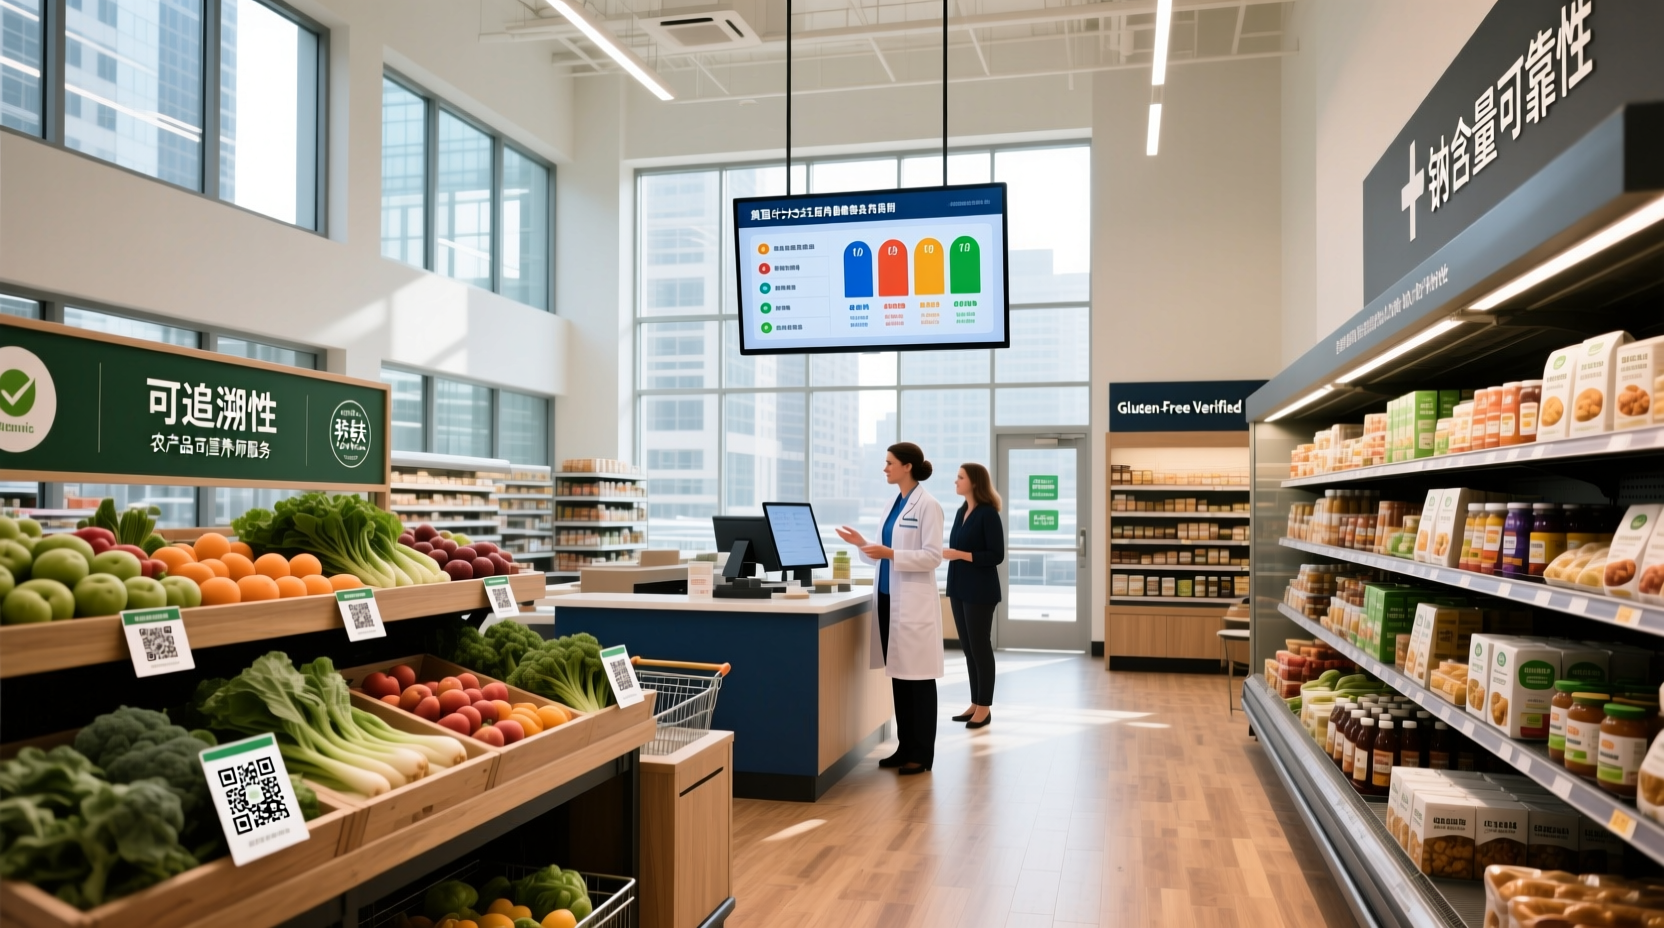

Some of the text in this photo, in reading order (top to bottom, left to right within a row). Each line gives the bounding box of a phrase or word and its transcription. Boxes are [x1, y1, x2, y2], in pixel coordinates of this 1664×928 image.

[1428, 0, 1593, 212] 钠含量可靠性
[146, 377, 278, 434] 可追溯性
[1117, 399, 1242, 415] Gluten-Free Verified
